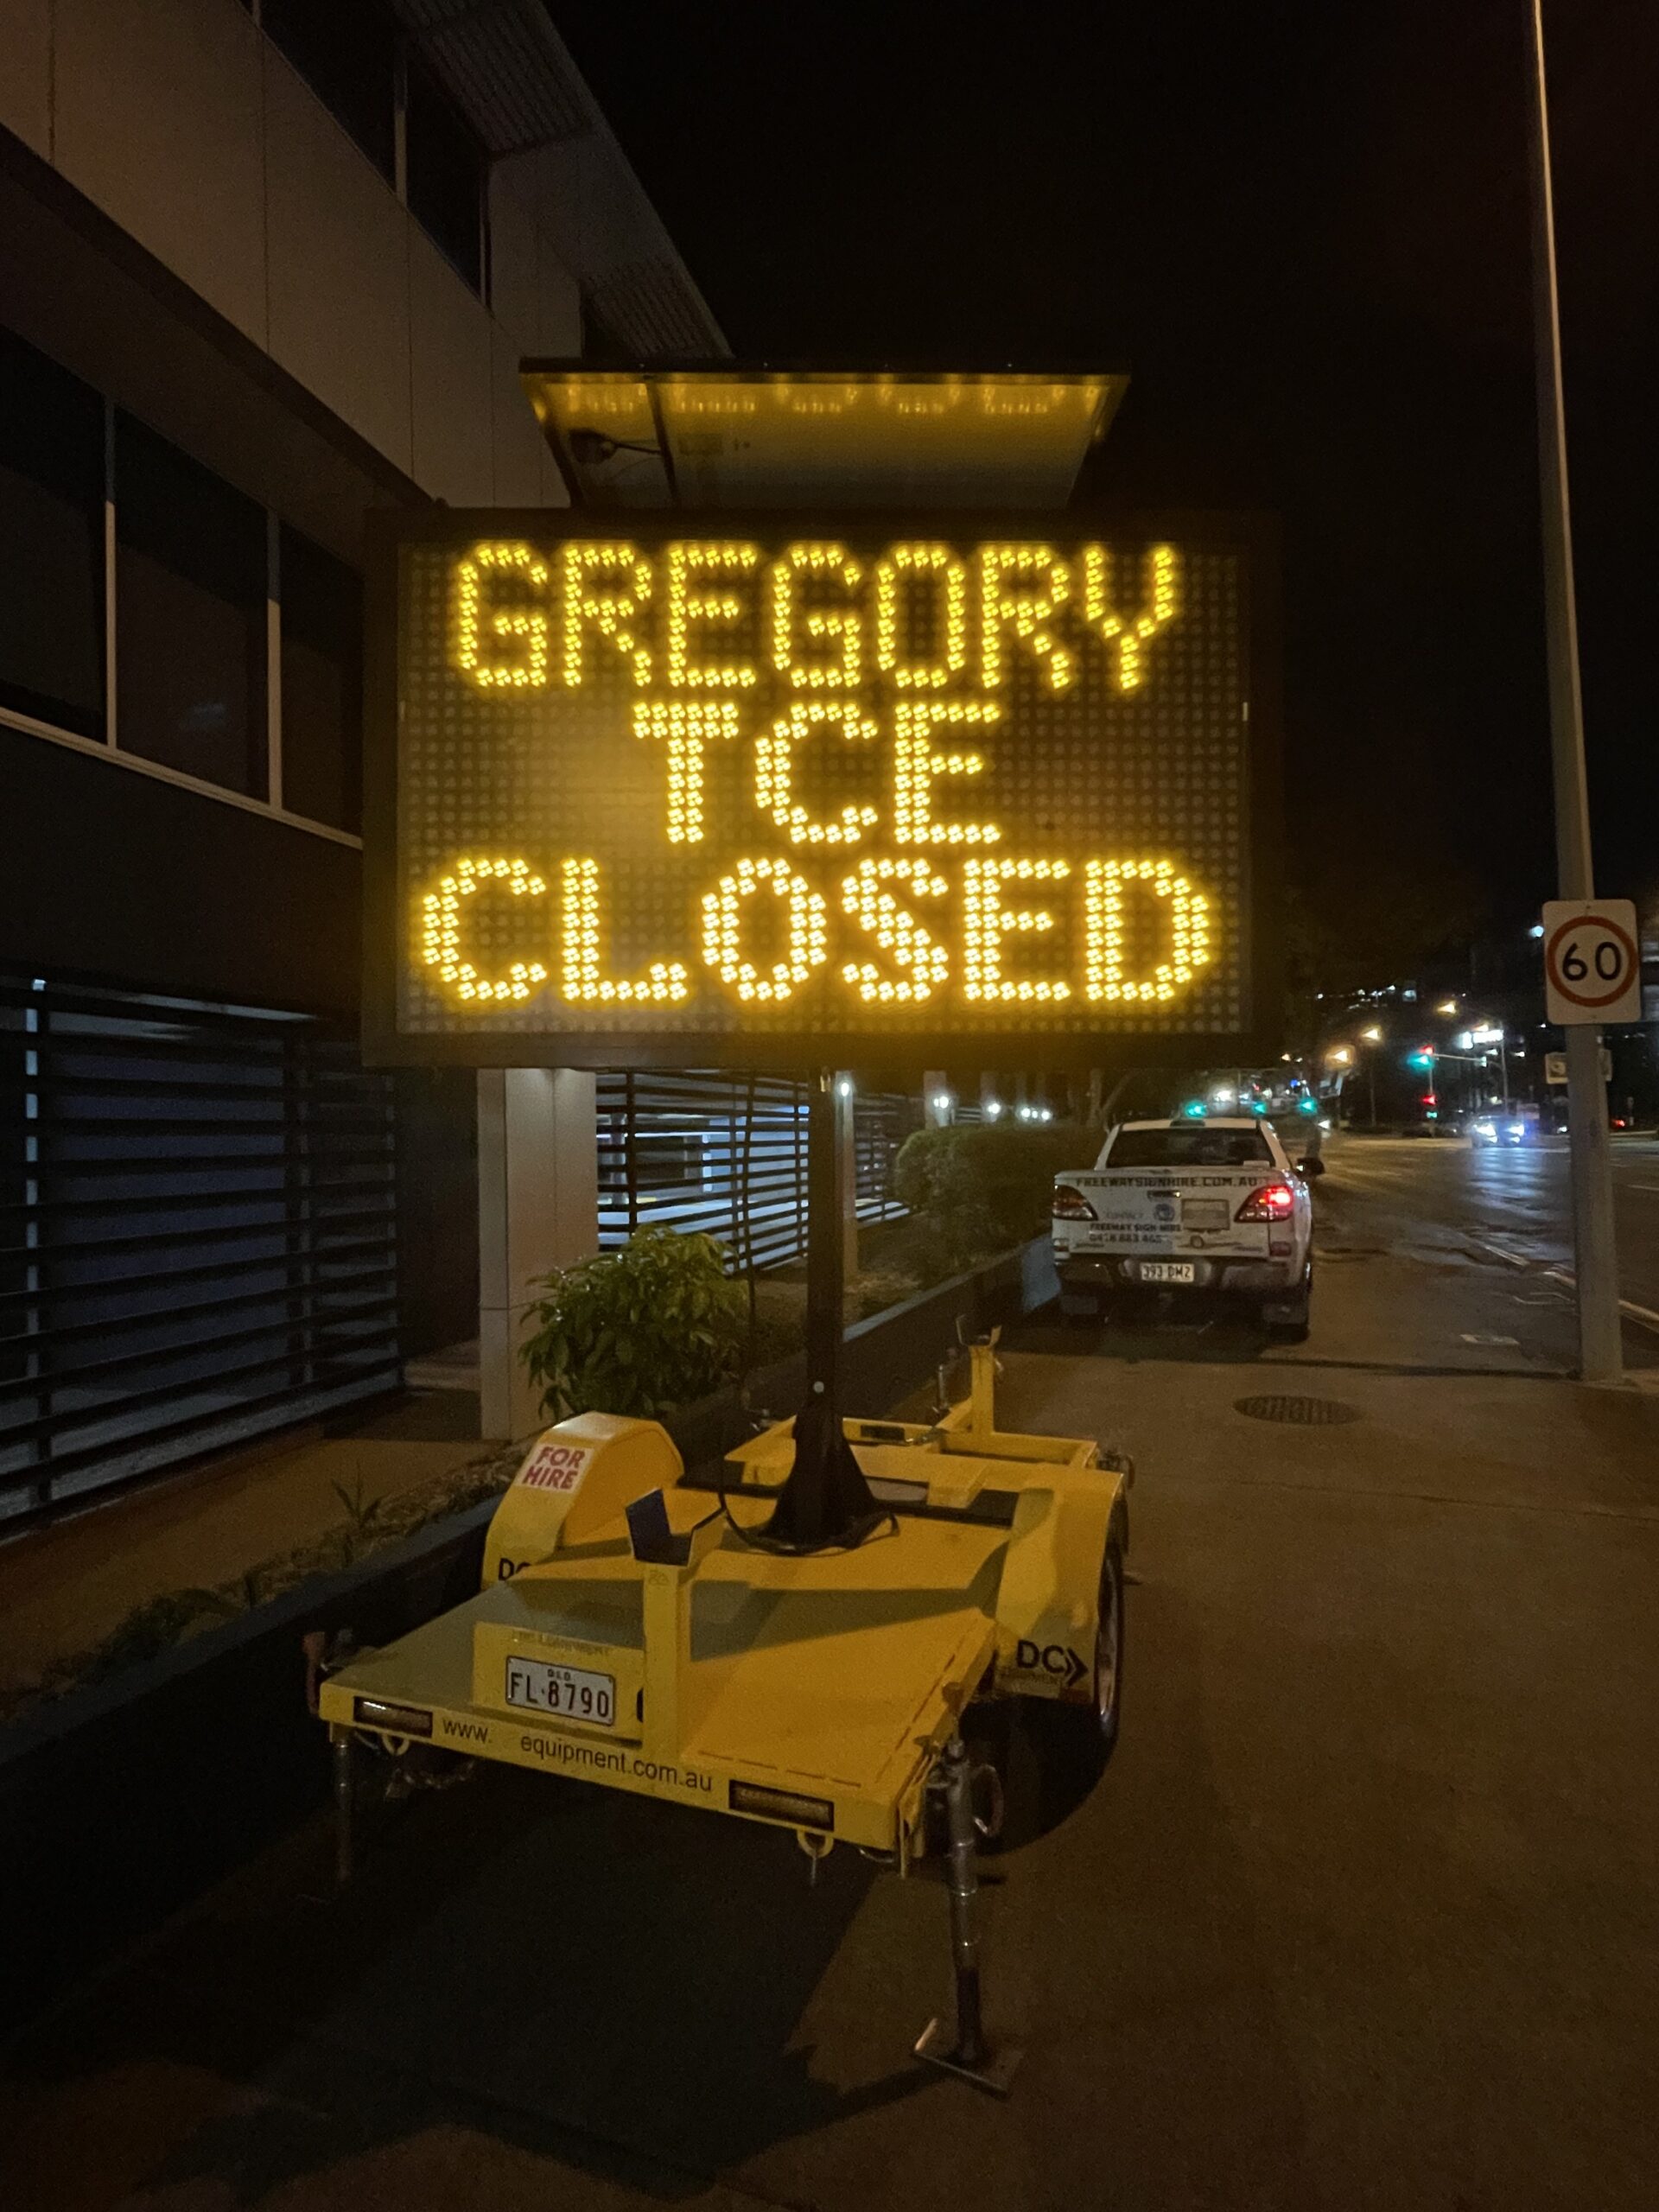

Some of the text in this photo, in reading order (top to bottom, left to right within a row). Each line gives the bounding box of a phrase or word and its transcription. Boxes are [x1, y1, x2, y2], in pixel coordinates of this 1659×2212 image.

[455, 542, 1177, 691] GREGORY
[632, 700, 1002, 844] TCE
[421, 857, 1211, 1002] CLOSED
[1561, 941, 1622, 982] 60
[522, 1465, 578, 1489] HIRE
[536, 1446, 585, 1468] FOR
[547, 1669, 571, 1681] QLD
[442, 1718, 713, 1791] www. equipment.com.au
